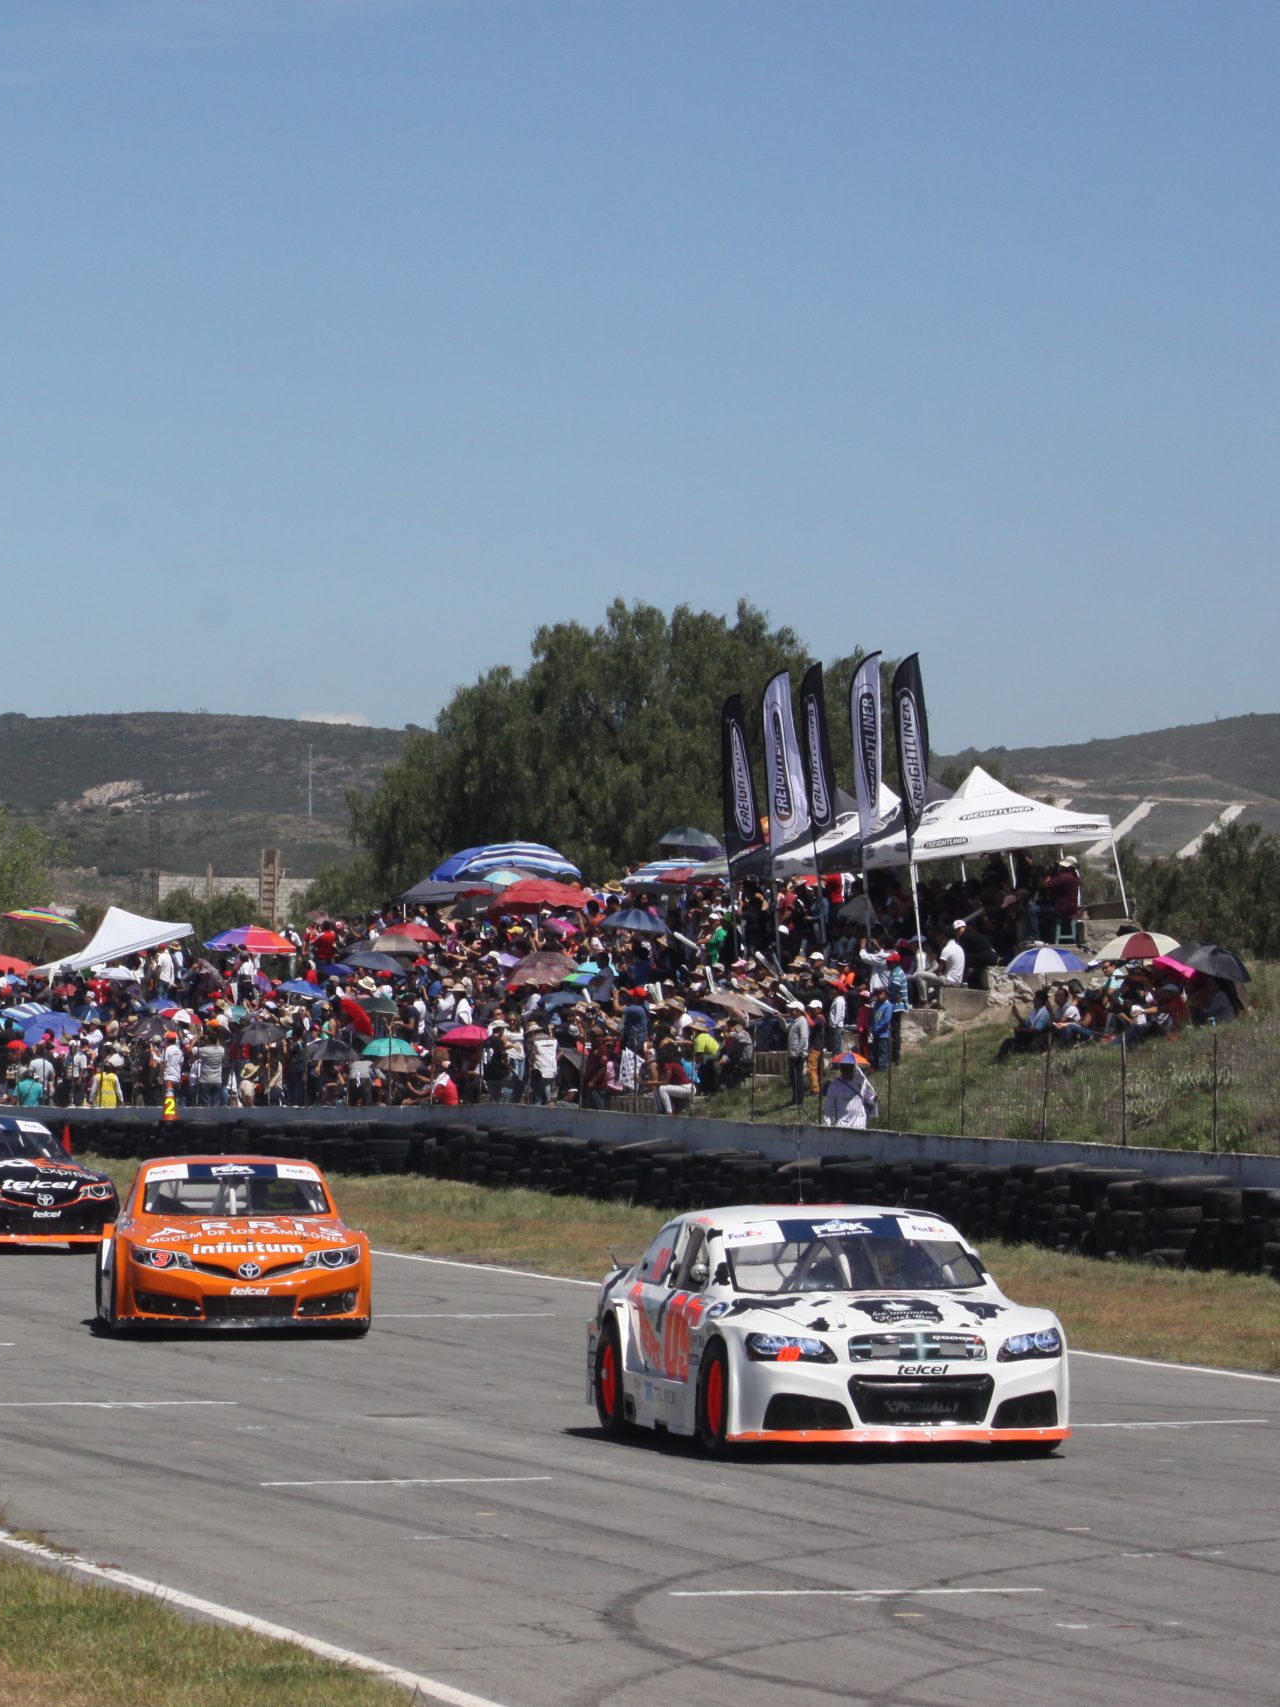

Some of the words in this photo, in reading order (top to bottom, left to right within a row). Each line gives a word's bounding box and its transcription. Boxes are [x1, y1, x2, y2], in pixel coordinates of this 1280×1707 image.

[902, 703, 922, 809] FREIGHTLINER
[961, 806, 1031, 821] FREIGHTLINER
[925, 838, 967, 848] FREIGHTLINER
[165, 1097, 175, 1115] 2
[38, 1167, 99, 1181] Express
[1, 1179, 78, 1191] telcel
[32, 1210, 62, 1218] telcel
[728, 1229, 767, 1240] FedEx
[811, 1221, 870, 1236] PEAK
[911, 1225, 945, 1233] FedEx
[146, 1232, 203, 1244] MODEM
[261, 1229, 347, 1244] CAMPEONES
[192, 1242, 303, 1255] infinitum
[152, 1251, 169, 1267] 3
[230, 1286, 270, 1296] telcel
[897, 1364, 949, 1375] telcel
